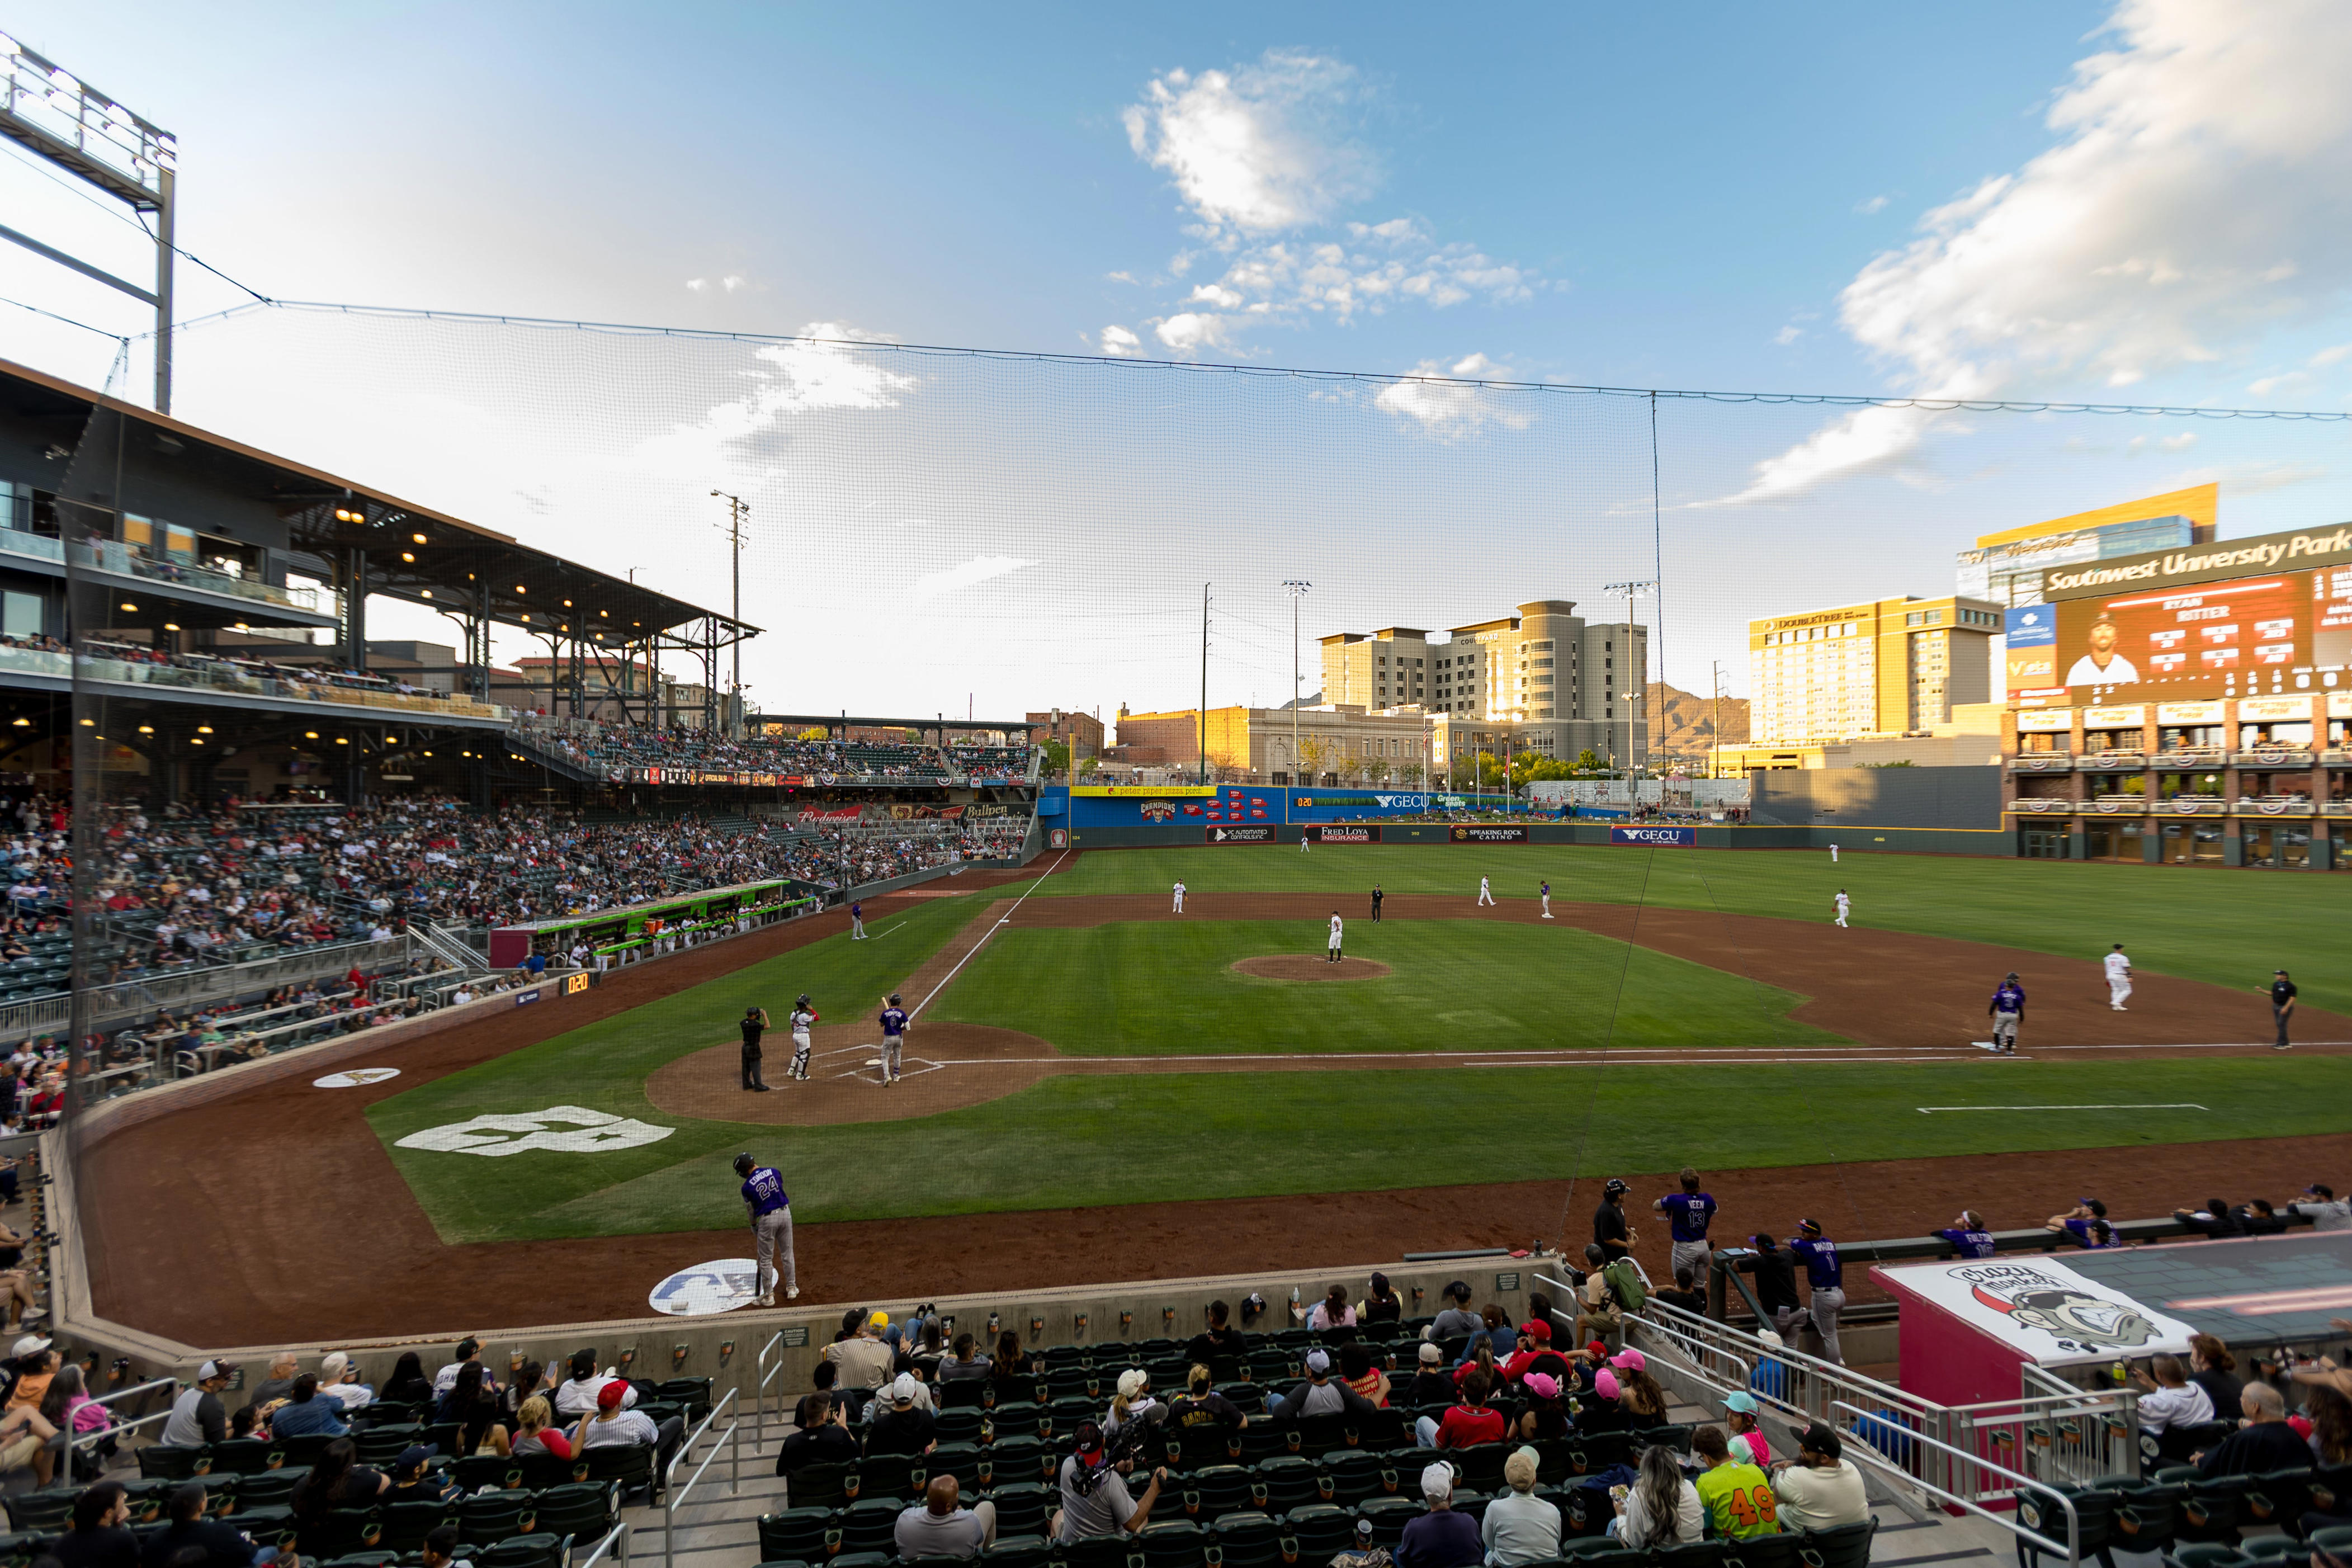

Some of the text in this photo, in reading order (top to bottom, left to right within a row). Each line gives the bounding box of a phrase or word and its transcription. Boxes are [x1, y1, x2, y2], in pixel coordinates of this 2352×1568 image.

[2047, 528, 2352, 591] Southwest University Park
[1141, 801, 1175, 813] CHAMPIONS
[1393, 795, 1429, 807] GECU
[967, 804, 1008, 818] Bullpen
[1639, 830, 1679, 840] GECU
[749, 1168, 773, 1186] CONDON
[756, 1175, 779, 1201] 24
[1688, 1199, 1704, 1209] VEEN
[1688, 1211, 1705, 1227] 13
[1826, 1252, 1836, 1271] 1
[1962, 1267, 2056, 1282] crazy
[1983, 1276, 2066, 1291] monkey
[1346, 1374, 1376, 1387] RYFFINDOR
[1354, 1380, 1378, 1393] FFLEPUFF
[1728, 1484, 1776, 1527] 49
